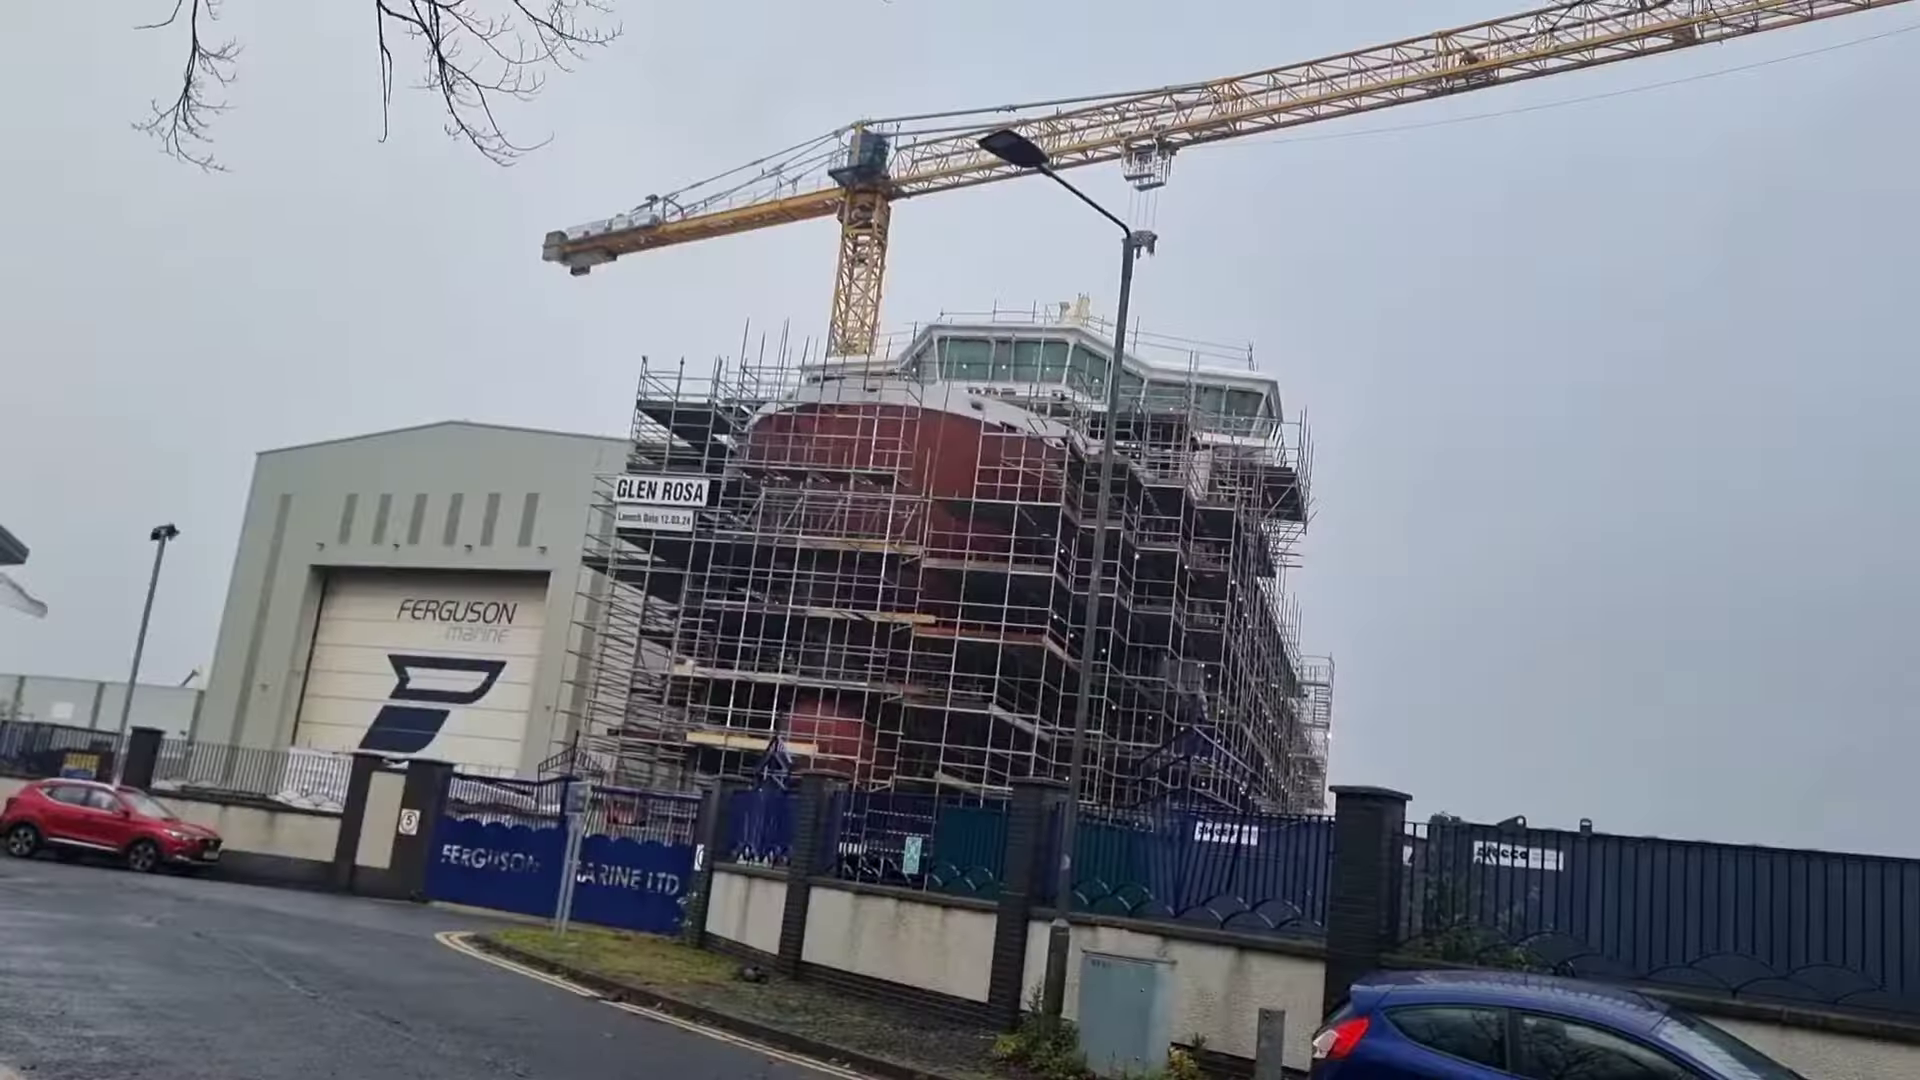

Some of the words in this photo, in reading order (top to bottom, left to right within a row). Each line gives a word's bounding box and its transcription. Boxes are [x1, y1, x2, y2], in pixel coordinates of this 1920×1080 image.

[617, 478, 658, 500] GLEN
[661, 481, 703, 502] ROSA
[397, 599, 518, 625] FERGUSON
[446, 625, 511, 644] marine
[405, 815, 413, 827] 5
[574, 858, 642, 890] ARINE
